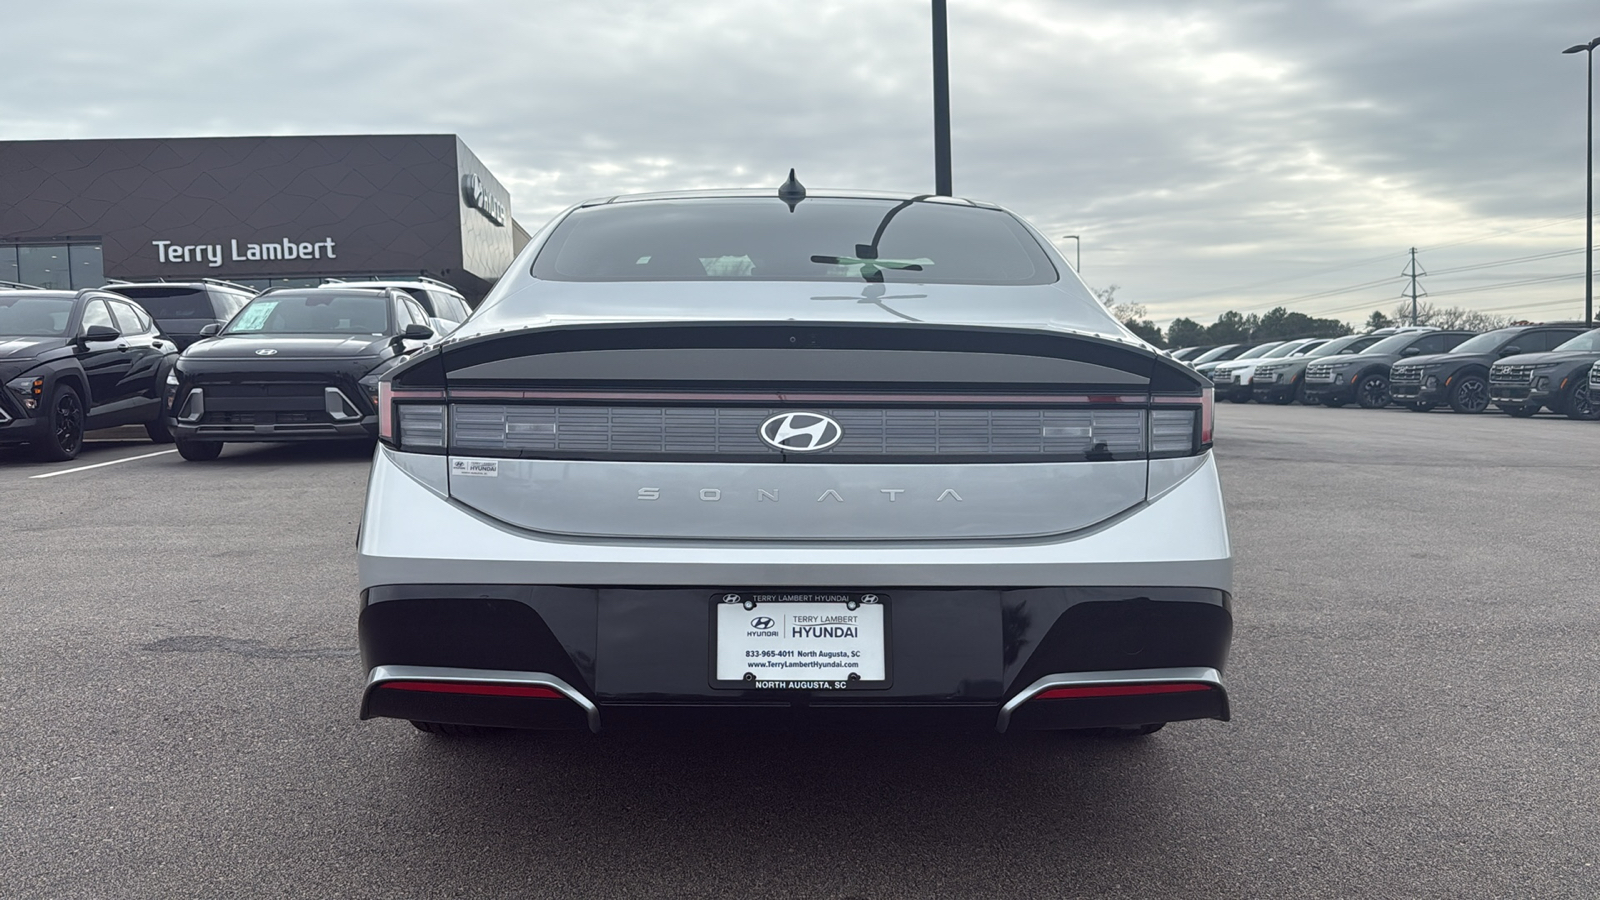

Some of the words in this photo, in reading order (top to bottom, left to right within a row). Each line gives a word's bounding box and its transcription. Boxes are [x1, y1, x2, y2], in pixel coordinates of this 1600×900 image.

[152, 240, 222, 267] Terry
[231, 237, 336, 261] Lambert
[637, 487, 963, 502] SONATA
[792, 627, 858, 638] HYUNDAI
[818, 651, 850, 659] Augusta,
[748, 661, 858, 669] www.TerryLambertHyundai.com
[788, 682, 832, 690] AUGUSTA,
